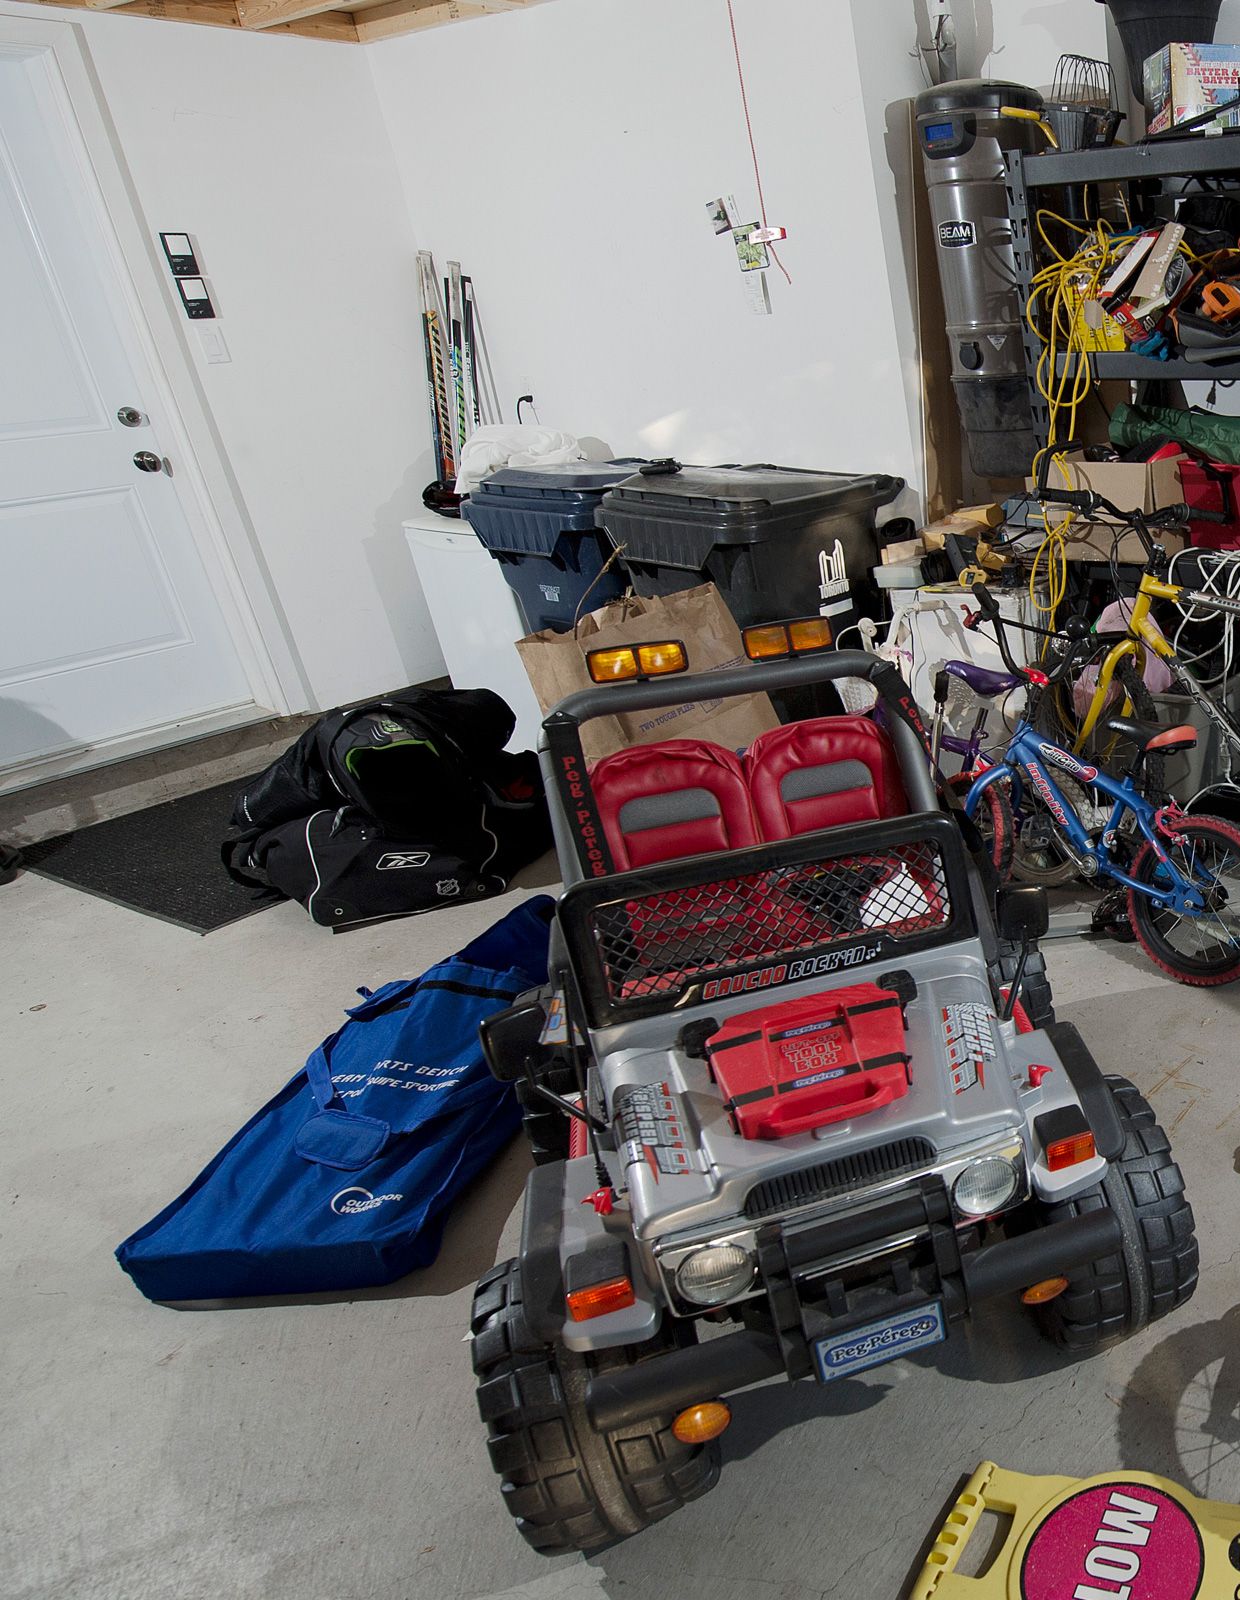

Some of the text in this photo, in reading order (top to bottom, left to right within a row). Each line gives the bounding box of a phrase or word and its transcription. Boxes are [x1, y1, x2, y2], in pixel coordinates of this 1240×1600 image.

[1187, 68, 1230, 77] BATTER
[940, 225, 971, 240] BEAM
[1113, 312, 1128, 326] 40
[1143, 316, 1156, 332] 40
[819, 580, 850, 600] TORONTO
[639, 702, 696, 733] TWO TOUGH PLIES
[1025, 762, 1070, 826] infinity
[703, 964, 788, 1001] GAUCHO
[786, 1041, 842, 1063] TOOL
[415, 1063, 470, 1078] BENCH
[794, 1053, 838, 1074] BOX
[345, 1192, 404, 1209] OUTDOOR
